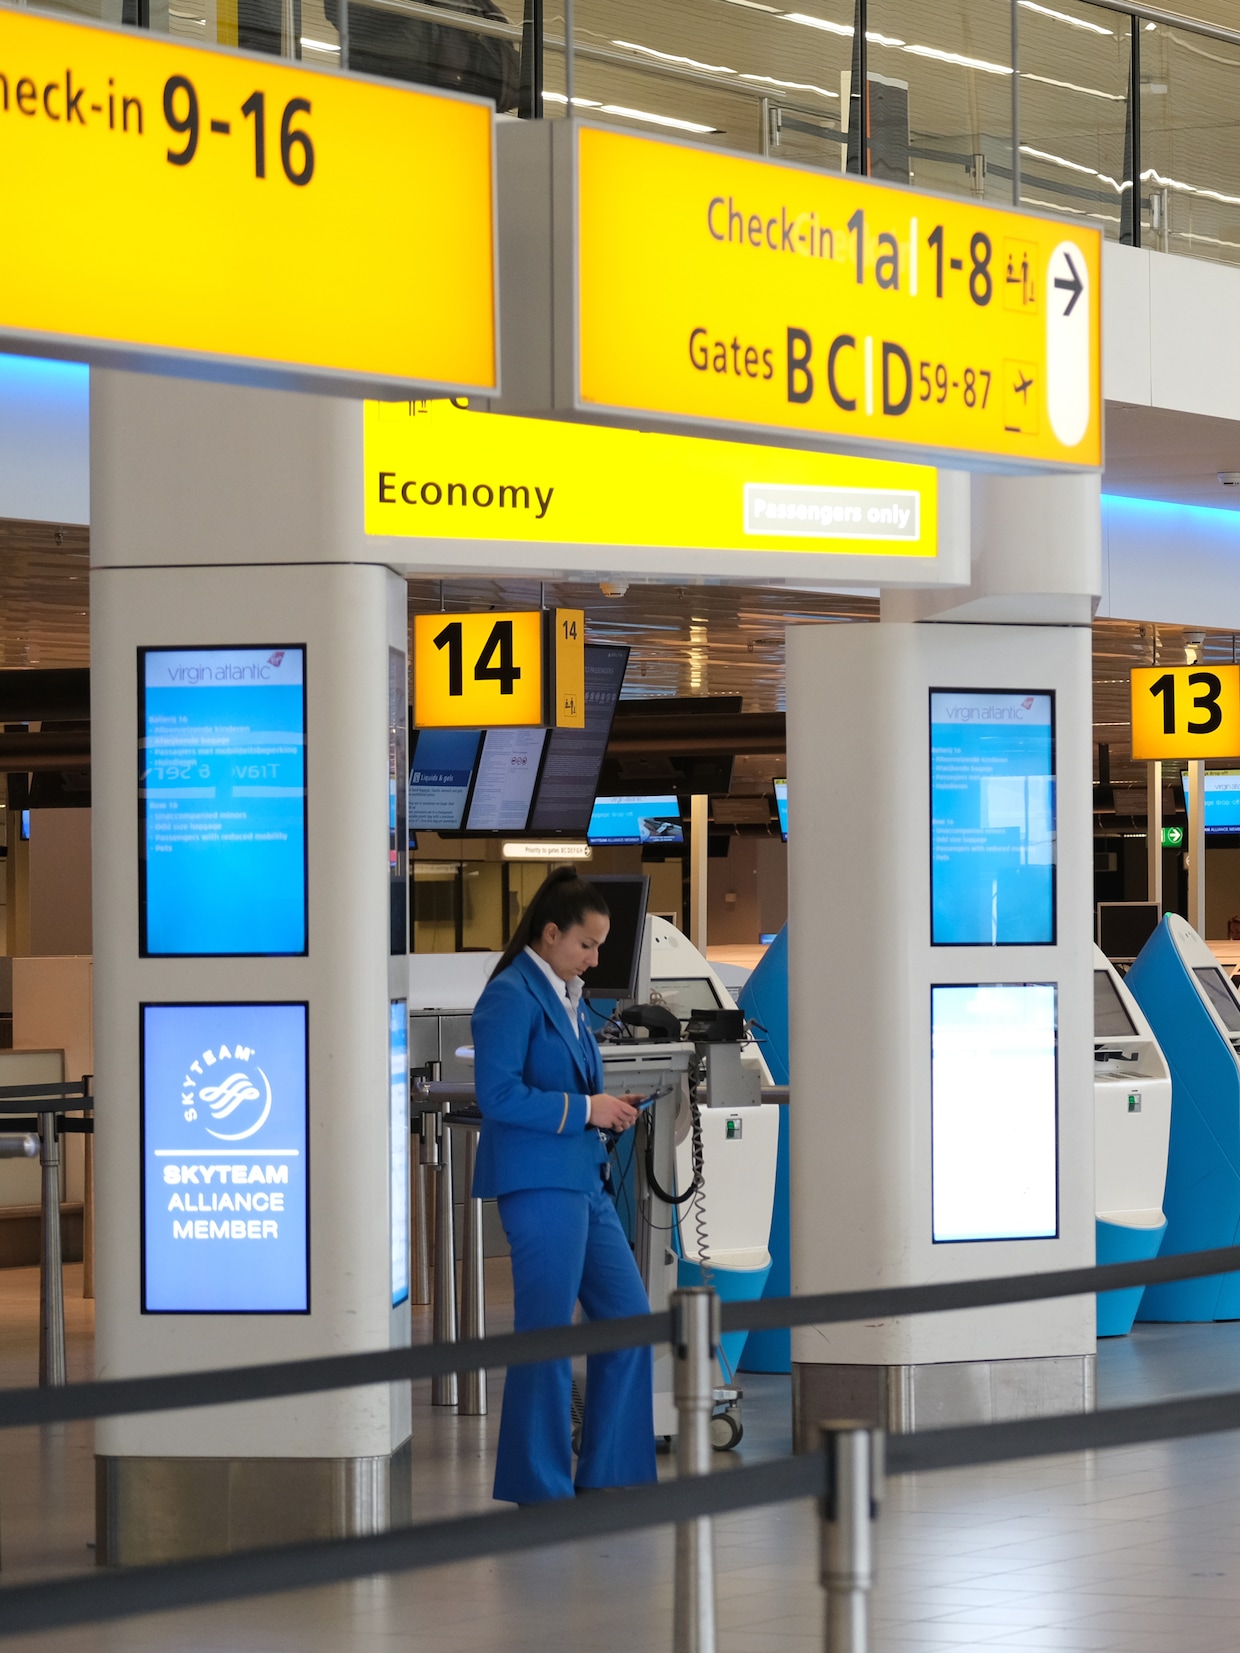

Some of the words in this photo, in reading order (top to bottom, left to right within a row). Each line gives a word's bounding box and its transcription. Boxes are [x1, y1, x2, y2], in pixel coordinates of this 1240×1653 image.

[162, 74, 315, 186] 9-16
[707, 196, 834, 260] Check-in
[927, 224, 993, 307] 1-8
[689, 327, 774, 380] Gates
[786, 325, 814, 404] B
[827, 333, 857, 412] C
[881, 340, 913, 417] D
[919, 360, 992, 409] 59-87
[378, 471, 555, 519] Economy
[753, 498, 862, 526] Passengers
[866, 503, 911, 529] only
[562, 620, 577, 640] 14
[168, 664, 213, 684] virgin
[214, 663, 271, 681] atlantic
[433, 620, 521, 696] 14
[945, 705, 980, 722] virgin
[981, 705, 1025, 720] atlantic
[1149, 672, 1223, 734] 13
[181, 1044, 252, 1123] SKYTEAM
[163, 1164, 289, 1184] SKYTEAM
[168, 1192, 285, 1212] ALLIANCE
[173, 1219, 279, 1239] MEMBER
